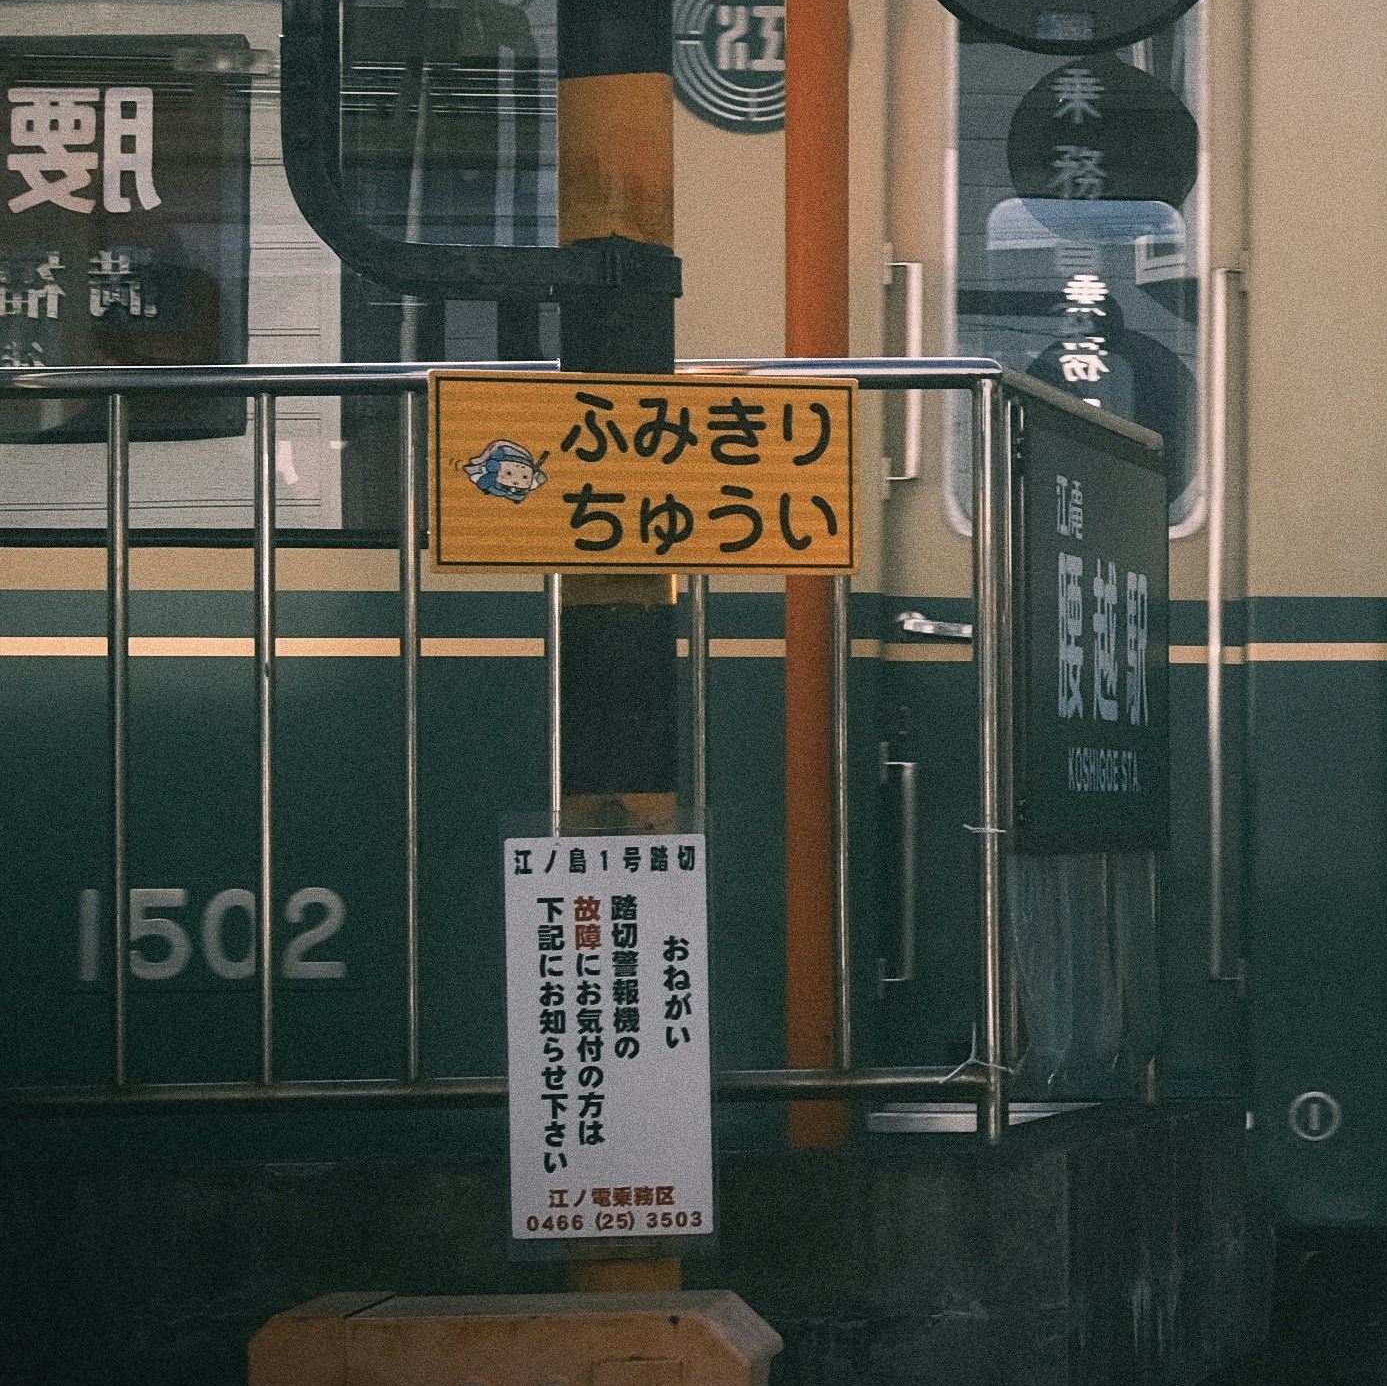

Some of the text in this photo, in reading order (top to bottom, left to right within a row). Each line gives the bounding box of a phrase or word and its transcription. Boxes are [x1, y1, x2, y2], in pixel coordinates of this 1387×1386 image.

[559, 391, 833, 466] ふみきり
[560, 483, 839, 557] ちゅうい
[1056, 550, 1150, 727] 腰越駅
[512, 844, 697, 875] 江ノ島1号踏切
[78, 887, 348, 982] 1502
[610, 894, 641, 1061] 踏切警報機の
[536, 896, 569, 1175] 下記にお知らせ下さい
[572, 895, 606, 1146] 故障にお気付の方は
[662, 934, 693, 1049] おねがい
[526, 1210, 703, 1232] 0466 (25) 3503
[548, 1186, 676, 1210] 江ノ電乗務区
